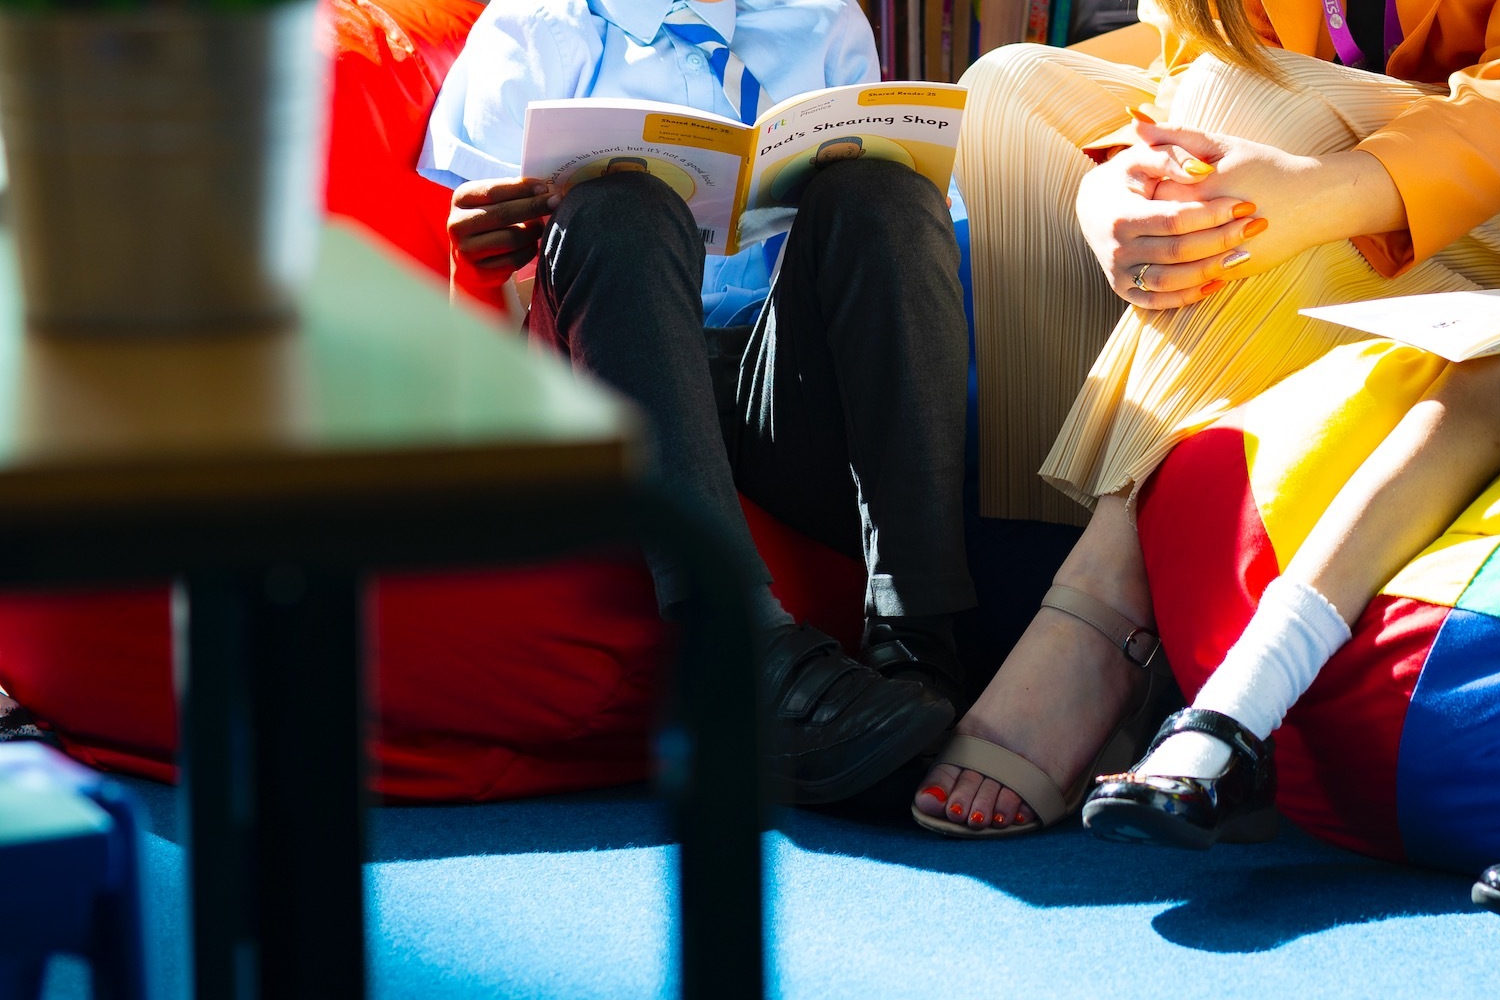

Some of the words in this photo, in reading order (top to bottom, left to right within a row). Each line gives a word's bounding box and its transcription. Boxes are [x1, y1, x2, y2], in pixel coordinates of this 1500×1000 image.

[661, 118, 689, 126] Shared
[691, 122, 718, 131] Reader
[800, 105, 832, 117] Phonics
[760, 131, 806, 156] Dad's
[812, 115, 895, 133] Shearing
[902, 114, 949, 130] Shop
[546, 171, 561, 185] Dad
[557, 159, 577, 176] trims
[577, 152, 591, 161] his
[592, 146, 624, 156] beard,
[646, 146, 660, 154] it's
[663, 151, 679, 160] not
[684, 161, 705, 176] good
[701, 173, 716, 187] look!
